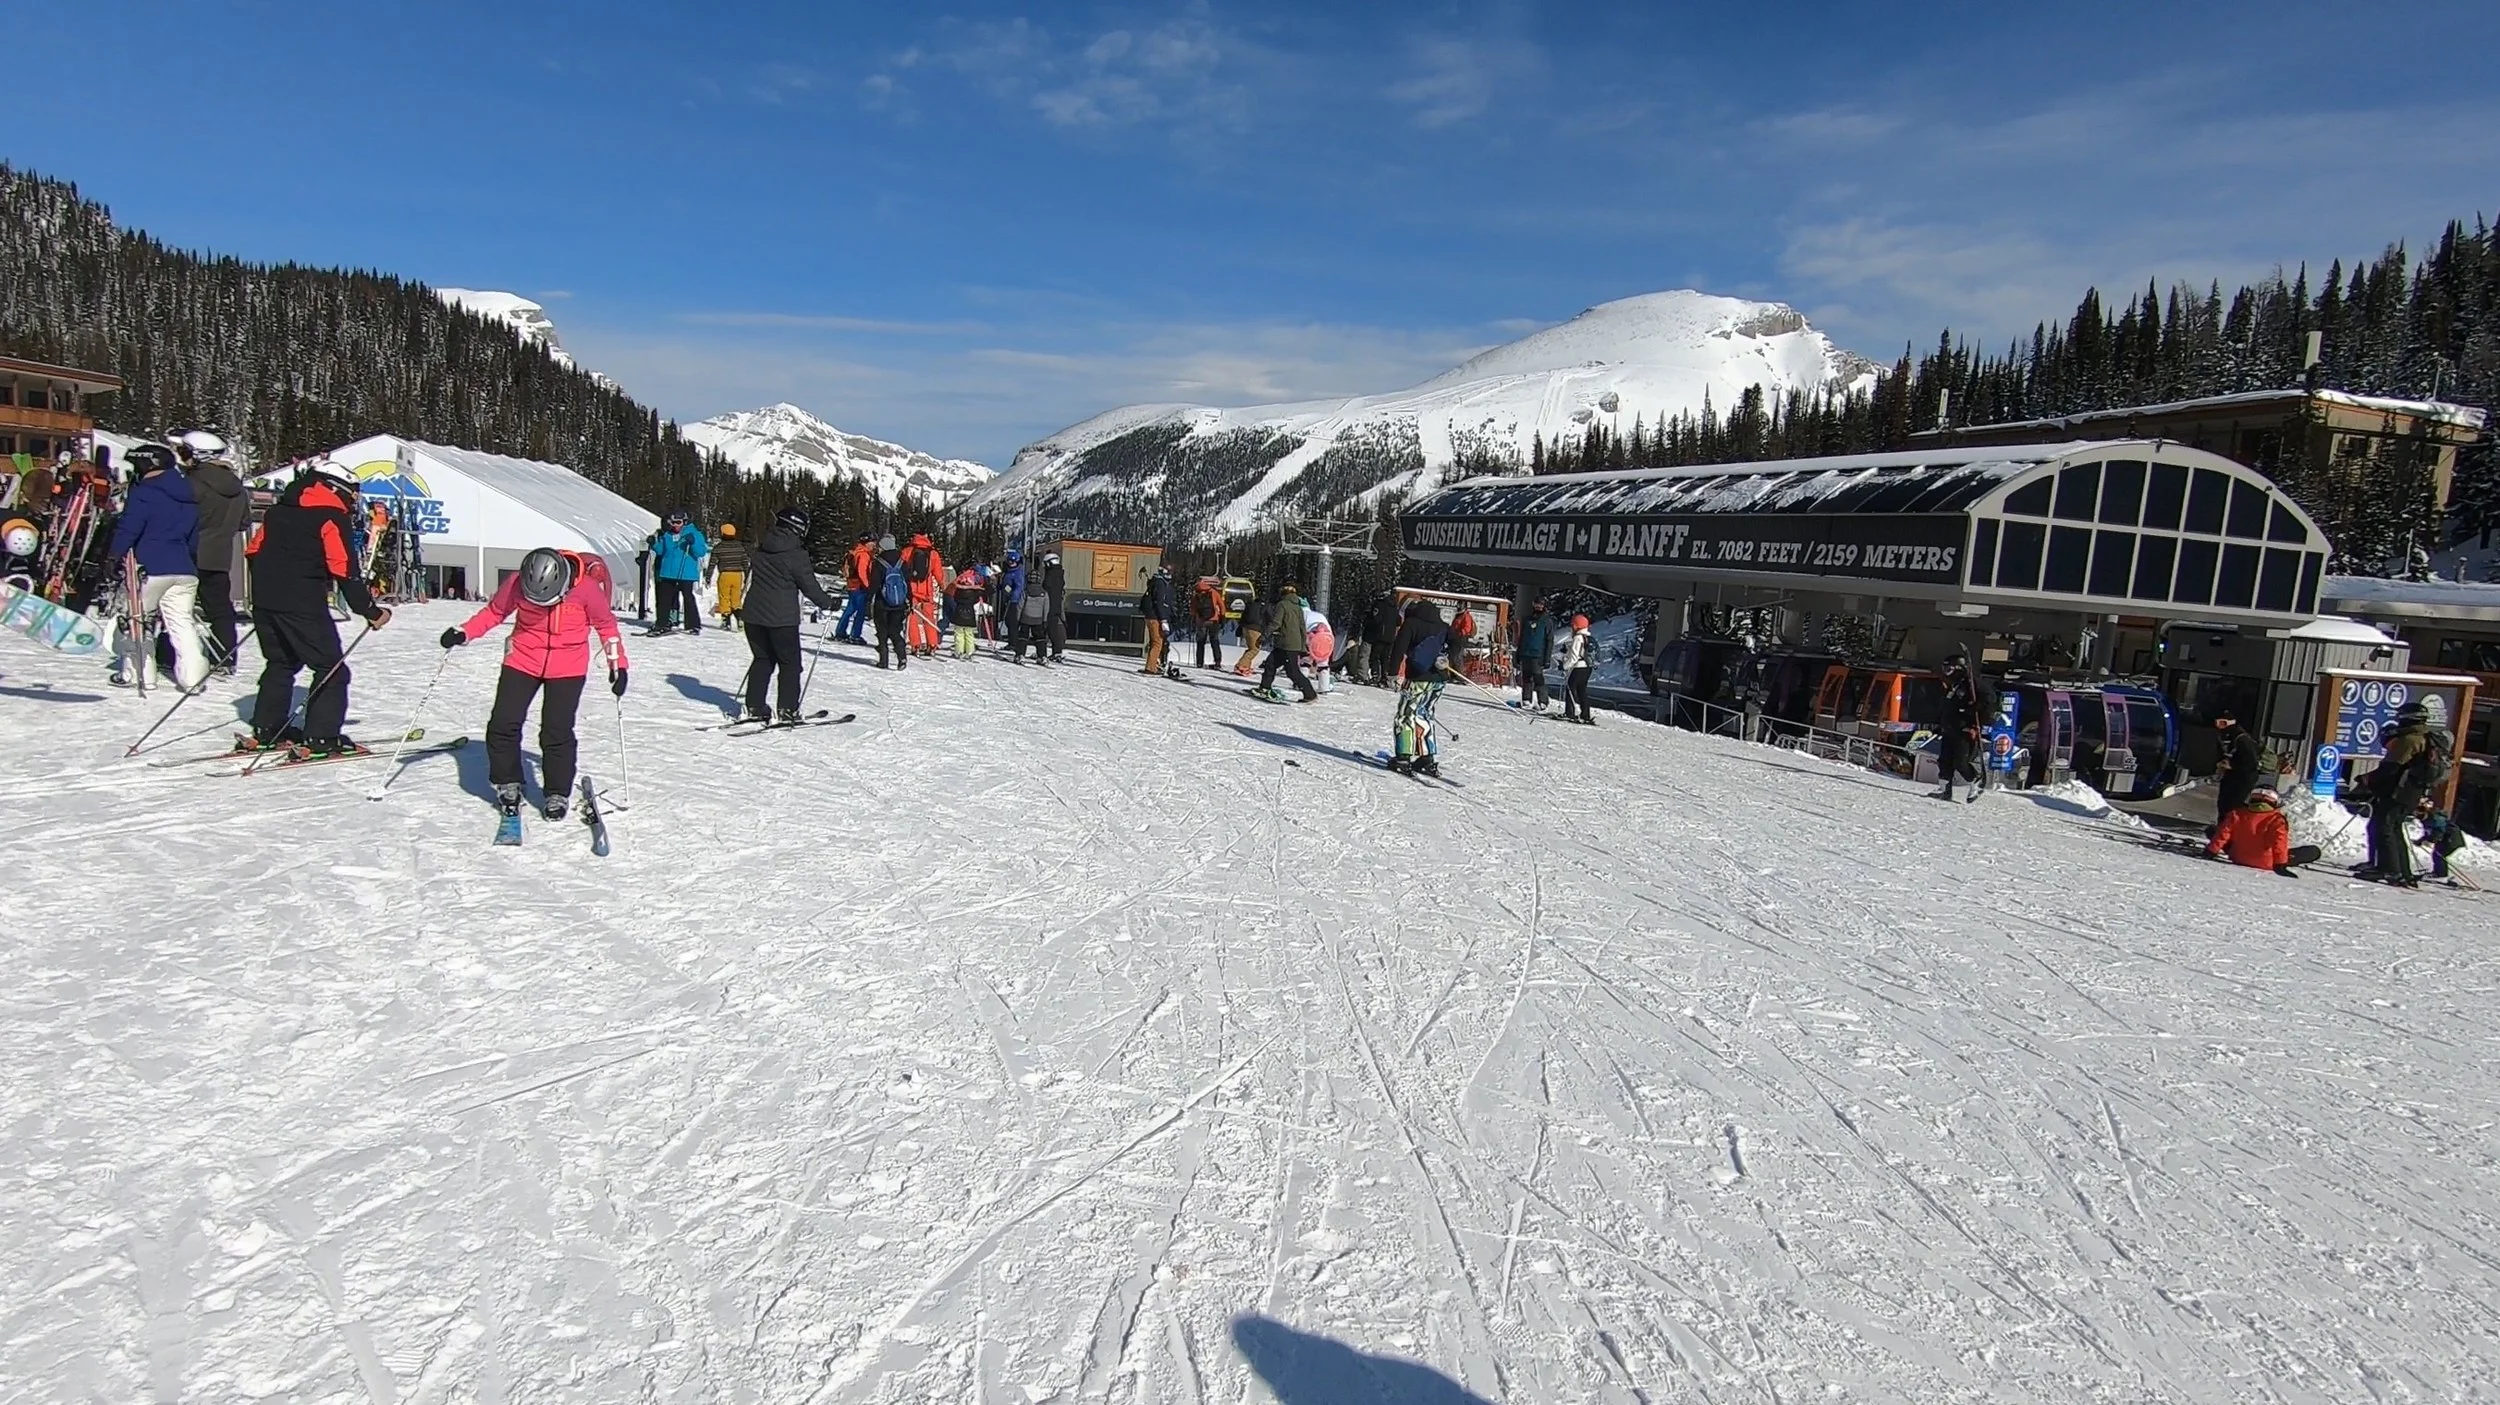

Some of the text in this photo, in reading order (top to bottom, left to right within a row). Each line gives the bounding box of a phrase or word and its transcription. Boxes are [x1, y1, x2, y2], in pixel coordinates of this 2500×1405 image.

[1414, 521, 1483, 548] SUNSHINE
[1486, 522, 1560, 551] VILLAGE
[1605, 524, 1690, 558] BANFF
[1690, 540, 1712, 560] EL.
[1716, 540, 1754, 561] 7082
[1757, 542, 1802, 565] FEET
[1813, 543, 1859, 567] 2159
[1862, 545, 1956, 571] METERS
